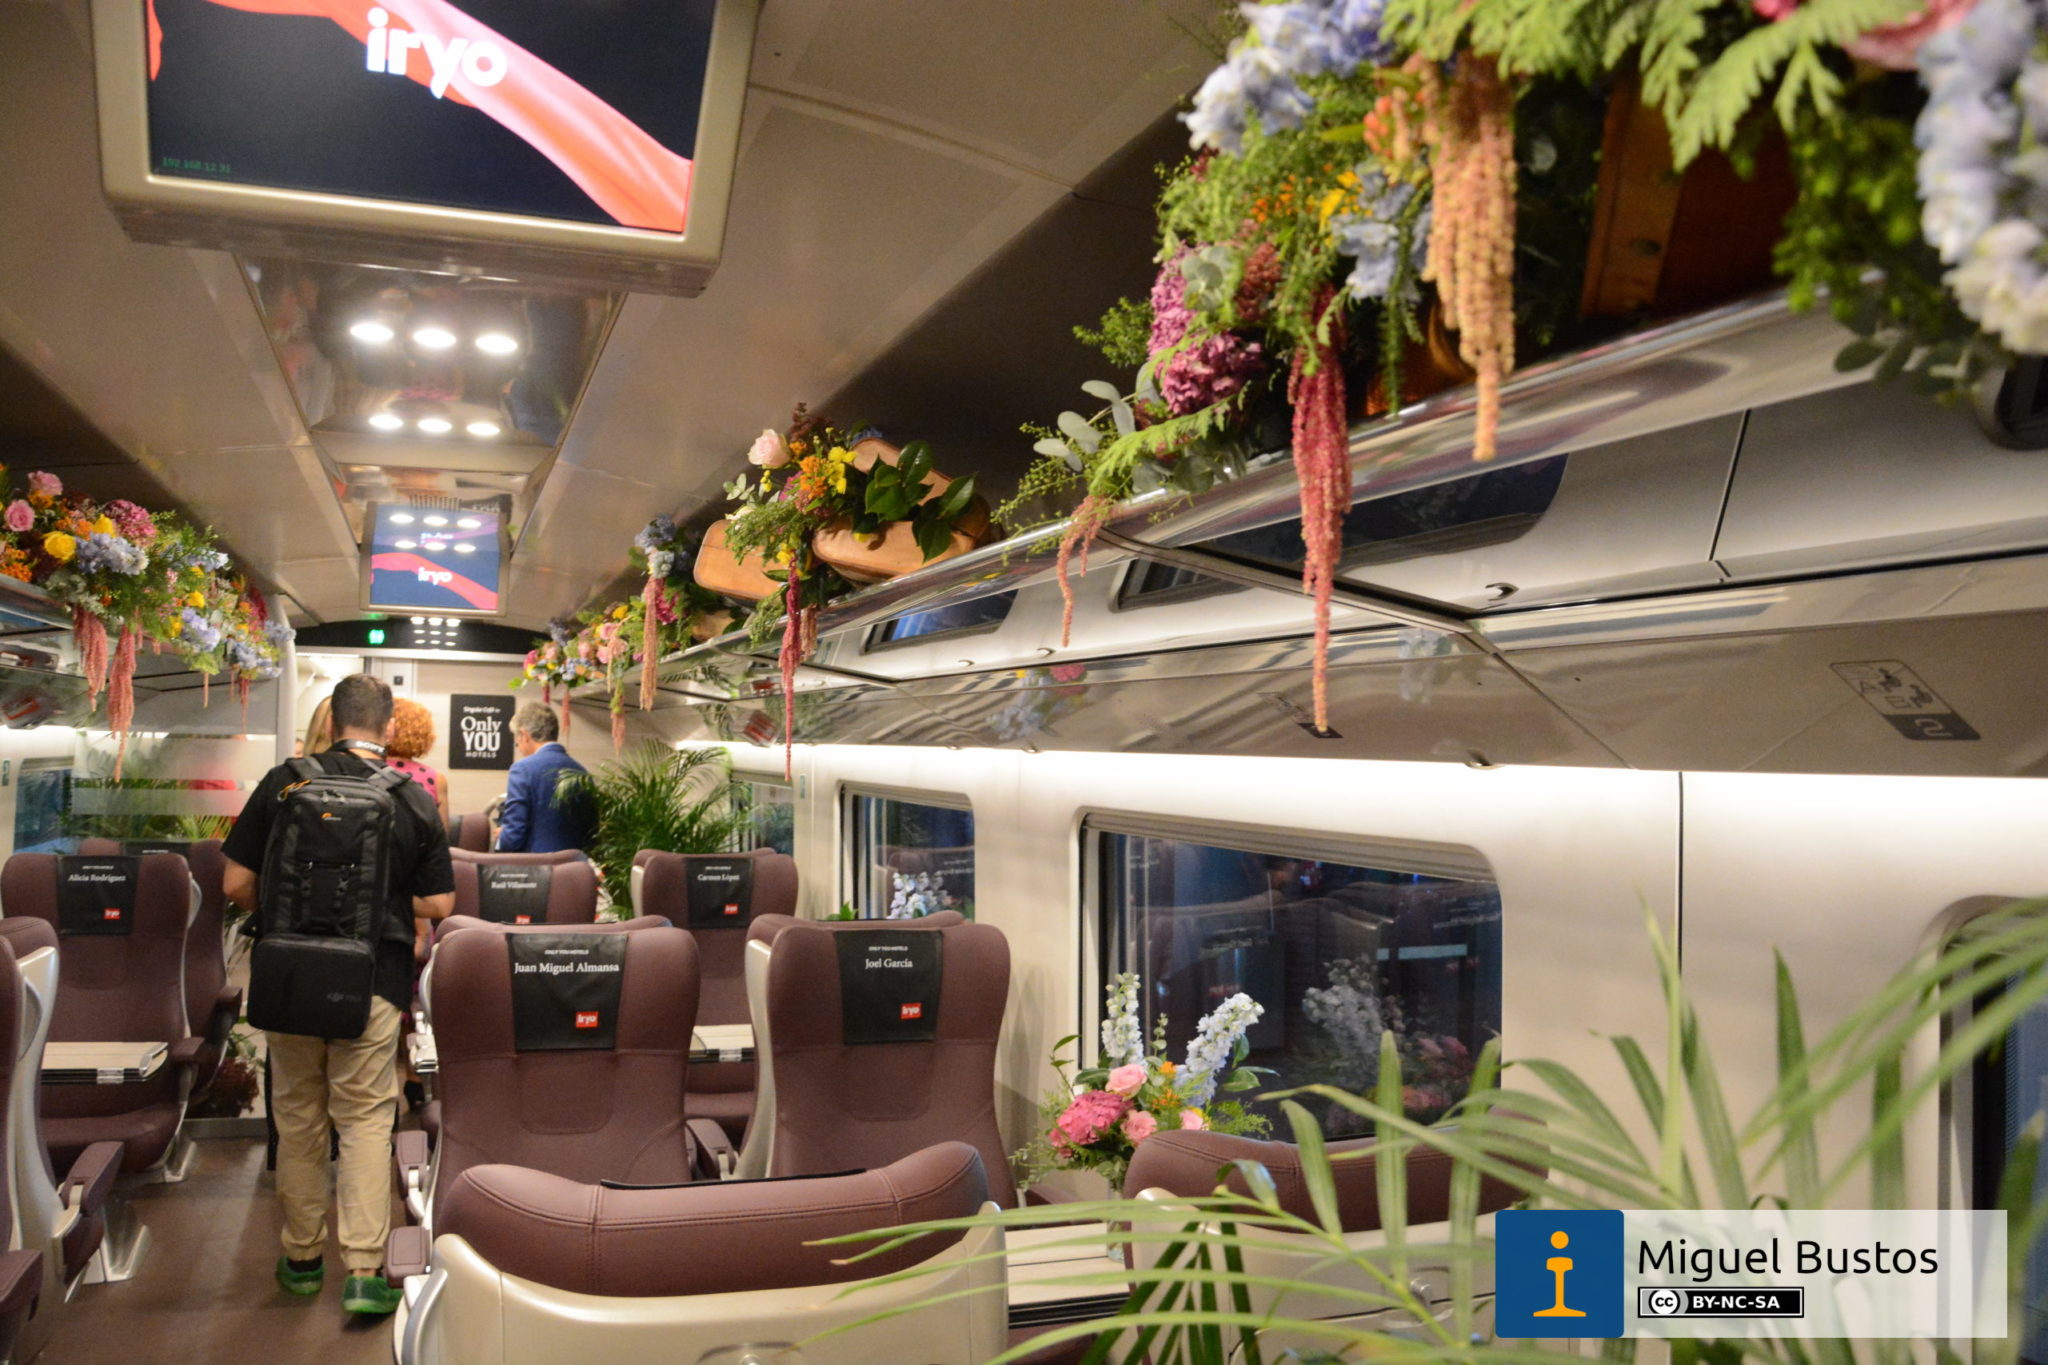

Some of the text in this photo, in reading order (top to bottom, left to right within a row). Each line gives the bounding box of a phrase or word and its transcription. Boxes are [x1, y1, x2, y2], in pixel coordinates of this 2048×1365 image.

[366, 7, 507, 99] iryo
[418, 566, 453, 586] iryo
[460, 715, 502, 736] Only
[1915, 718, 1953, 737] 2
[462, 731, 501, 752] YOU
[465, 751, 497, 759] HOTELS
[514, 962, 620, 975] Juan Miguel Almansa
[865, 958, 913, 970] Joel García
[902, 1005, 920, 1016] iryo
[577, 1014, 597, 1025] iryo
